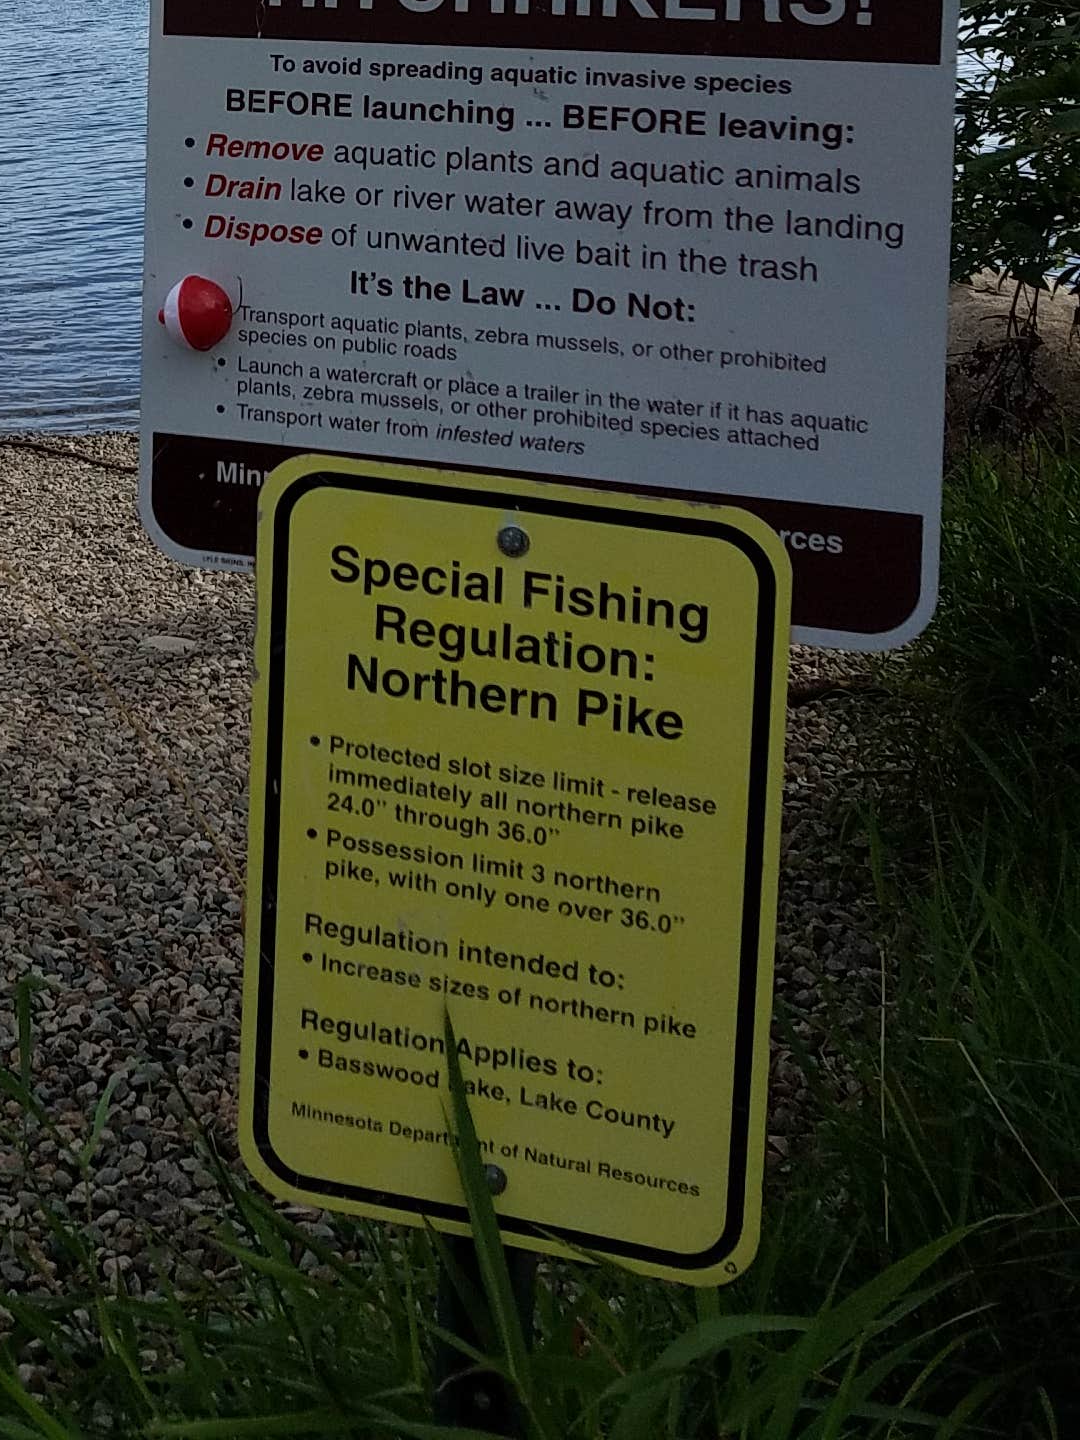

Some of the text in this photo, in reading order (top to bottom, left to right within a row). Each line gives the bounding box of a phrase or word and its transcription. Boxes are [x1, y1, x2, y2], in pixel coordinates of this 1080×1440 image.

[270, 54, 792, 96] To avoid spreading aquatic invasive species
[227, 89, 352, 117] BEFORE
[364, 95, 514, 132] launching
[563, 105, 706, 135] BEFORE
[719, 112, 854, 150] leaving:
[206, 134, 860, 194] Remove aquatic plants and aquatic animals
[205, 174, 903, 249] Drain lake or river water away from the landing
[205, 215, 817, 282] Dispose of unwanted live bait in the trash
[351, 271, 392, 296] It's
[403, 275, 451, 301] the
[463, 279, 524, 307] Law
[573, 288, 616, 315] Do
[628, 293, 695, 322] Not:
[239, 305, 826, 373] Transport aquatic plants, zebra mussels, or other prohibited
[239, 330, 457, 360] species on public roads
[237, 403, 585, 455] Transport water from infested waters
[238, 356, 868, 433] Launch a watercraft or place a trailer in the water if it has aquatic
[238, 378, 819, 451] plants, zebra mussels, or other prohibited species attached
[331, 545, 708, 643] Special Fishing
[375, 604, 655, 682] Regulation:
[348, 653, 683, 740] Northern Pike
[328, 764, 684, 839] immediately all northern pike
[330, 735, 440, 771] Protected
[448, 757, 491, 780] slot
[499, 765, 545, 788] size
[553, 771, 604, 798] limit
[628, 787, 716, 815] release
[395, 804, 488, 838] through
[326, 859, 379, 886] pike,
[389, 870, 436, 893] with
[446, 882, 496, 908] only
[505, 892, 549, 912] one
[558, 901, 613, 923] over
[327, 828, 660, 903] Possession limit 3 northern
[304, 912, 624, 990] Regulation intended to:
[322, 953, 696, 1038] Increase sizes of northern pike
[301, 1008, 602, 1085] Regulation Applies to:
[318, 1048, 675, 1139] Basswood ake, Lake County
[292, 1102, 699, 1196] Minnesota Departnt of Natural Resources
